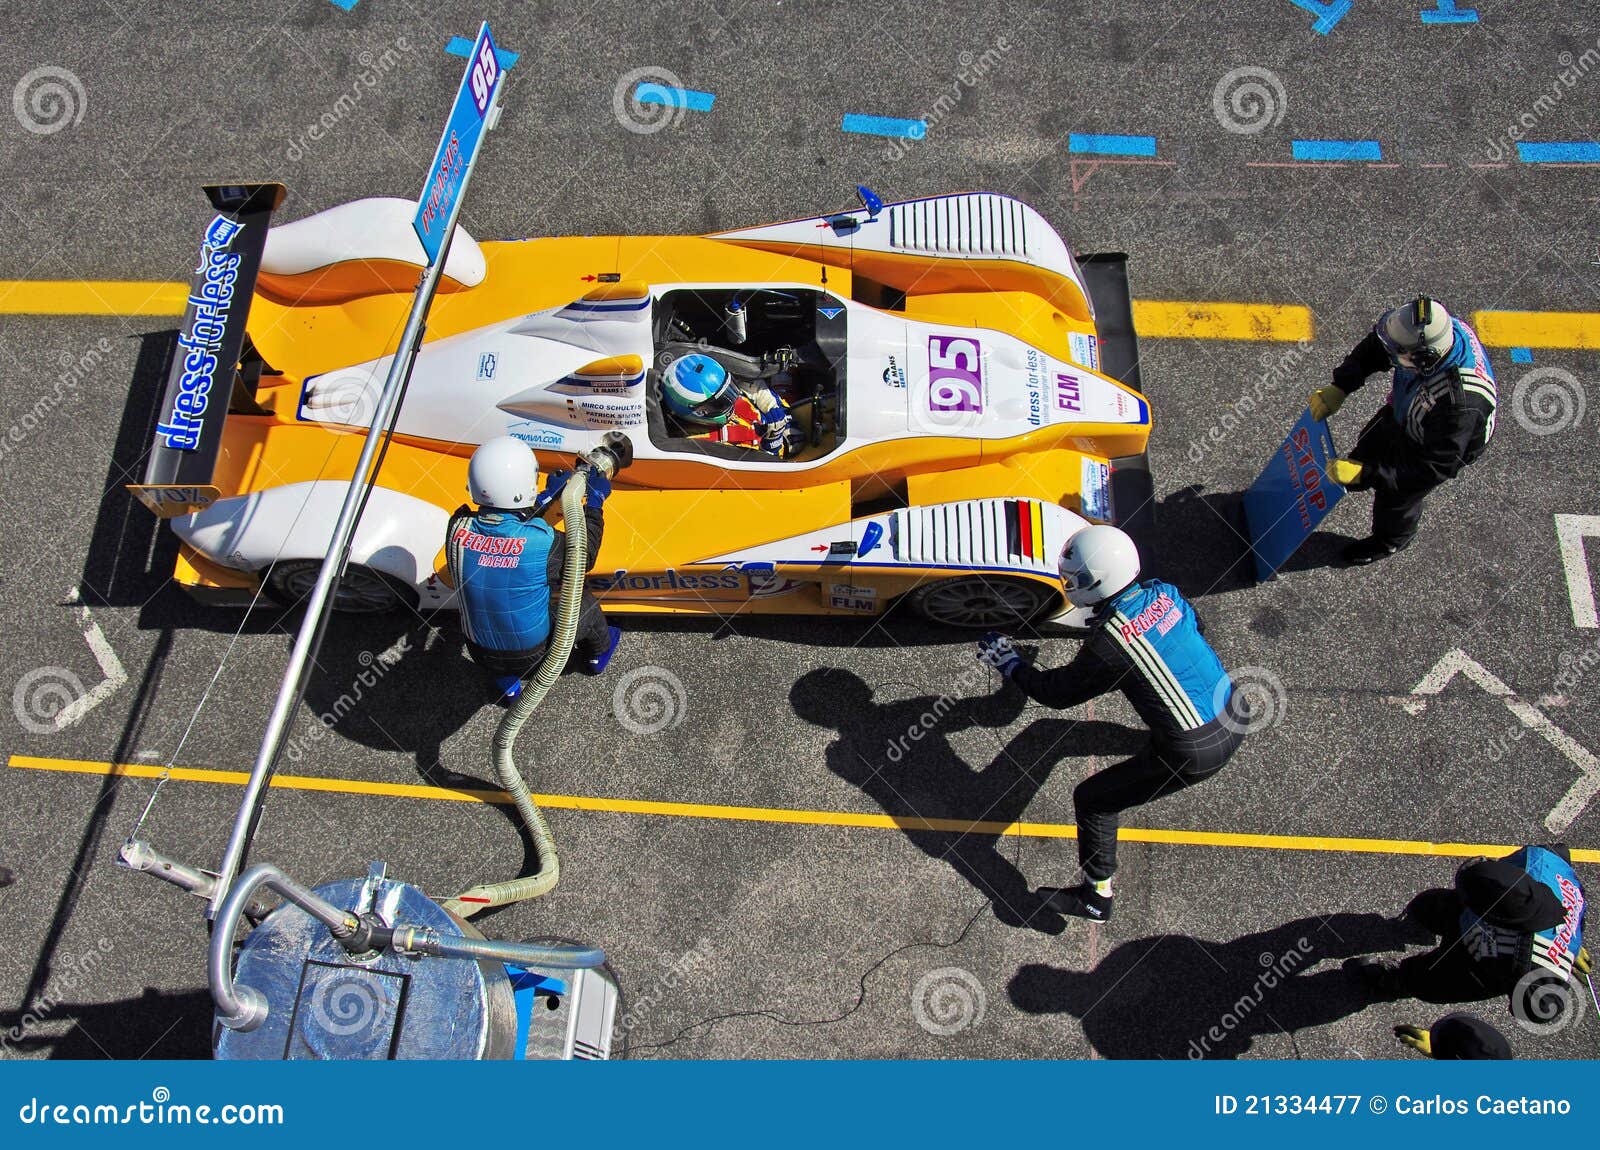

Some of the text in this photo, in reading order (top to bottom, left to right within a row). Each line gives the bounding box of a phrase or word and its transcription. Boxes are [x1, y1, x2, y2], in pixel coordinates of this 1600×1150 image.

[471, 36, 498, 110] 95
[421, 129, 459, 235] PEGASUS
[155, 250, 241, 450] dressforless
[930, 338, 980, 407] 95
[581, 401, 605, 410] MIRCO
[1026, 391, 1041, 426] dress
[1057, 373, 1081, 411] FLM
[586, 411, 616, 419] PATRICK
[1293, 428, 1327, 512] STOP
[452, 527, 527, 556] PEGASUS
[477, 554, 520, 569] RACING
[832, 596, 873, 611] FLM
[1121, 592, 1175, 644] PEGASUS
